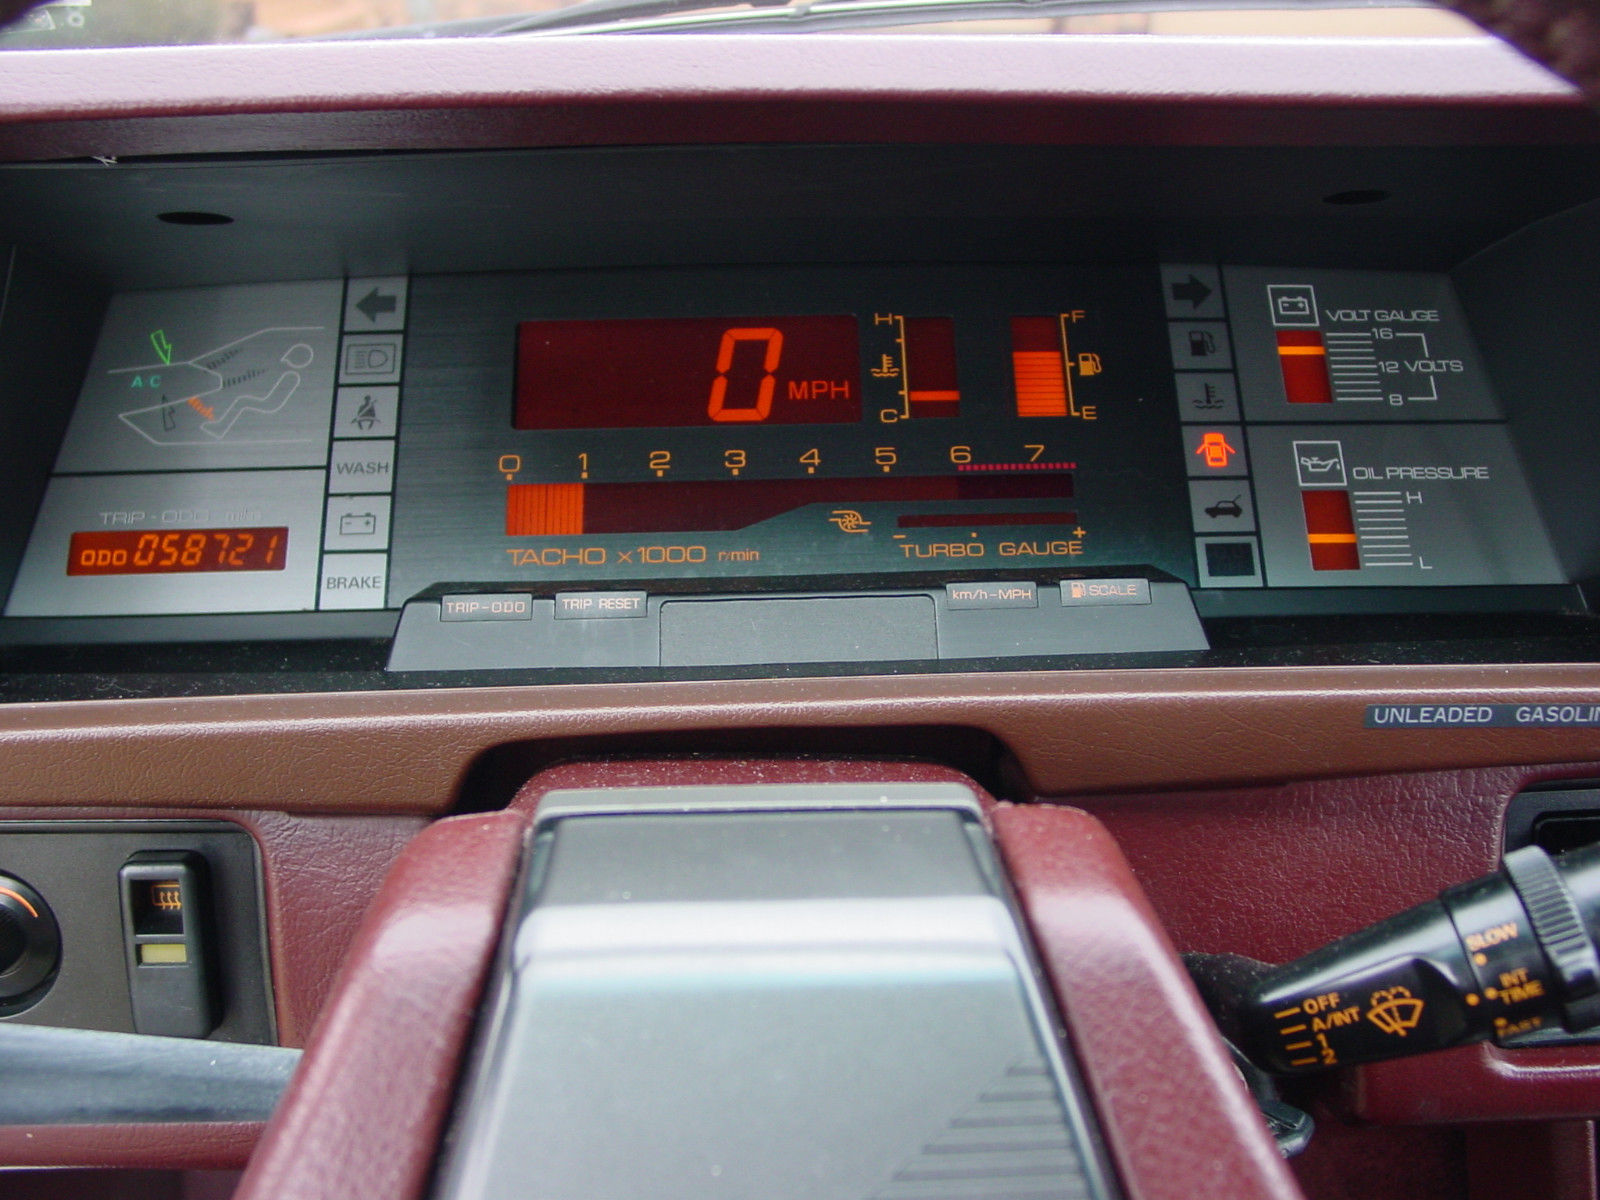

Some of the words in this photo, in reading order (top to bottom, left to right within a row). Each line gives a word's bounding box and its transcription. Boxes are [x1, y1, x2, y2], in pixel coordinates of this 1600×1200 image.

[874, 312, 893, 326] H
[1071, 310, 1085, 323] F
[1325, 310, 1371, 321] VOLT
[1375, 309, 1439, 321] GAUGE
[1371, 327, 1393, 340] 16
[1378, 361, 1400, 374] 12
[1403, 360, 1464, 373] VOLTS
[707, 328, 783, 422] 0
[787, 381, 850, 400] MPH
[1388, 394, 1404, 406] 8
[880, 409, 899, 423] C
[1082, 406, 1098, 420] E
[499, 455, 522, 472] 0
[578, 453, 588, 470] 1
[649, 450, 671, 469] 2
[724, 450, 747, 468] 3
[799, 448, 821, 466] 4
[874, 447, 897, 465] 5
[950, 445, 972, 464] 6
[1024, 444, 1045, 462] 7
[336, 462, 390, 475] WASH
[1352, 467, 1383, 480] OIL
[1386, 467, 1490, 480] PRESSURE
[1406, 490, 1423, 504] H
[80, 549, 128, 566] ODO
[132, 533, 280, 566] 058721
[506, 548, 606, 566] TACHO
[718, 549, 760, 561] r/min
[900, 543, 985, 558] TURBO
[999, 541, 1083, 556] GAUGE
[1419, 556, 1433, 570] L
[326, 575, 382, 590] BRAKE
[1089, 584, 1137, 596] SCALE
[562, 599, 592, 610] TRIP
[598, 597, 641, 610] RESET
[1373, 706, 1493, 724] UNLEADED
[1465, 923, 1518, 952] SLOW
[1500, 968, 1528, 988] INT
[1499, 980, 1545, 1005] TIME
[1303, 992, 1341, 1015] OFF
[1311, 1005, 1361, 1033] A/INT
[1316, 1032, 1330, 1049] 1
[1321, 1047, 1338, 1065] 2
